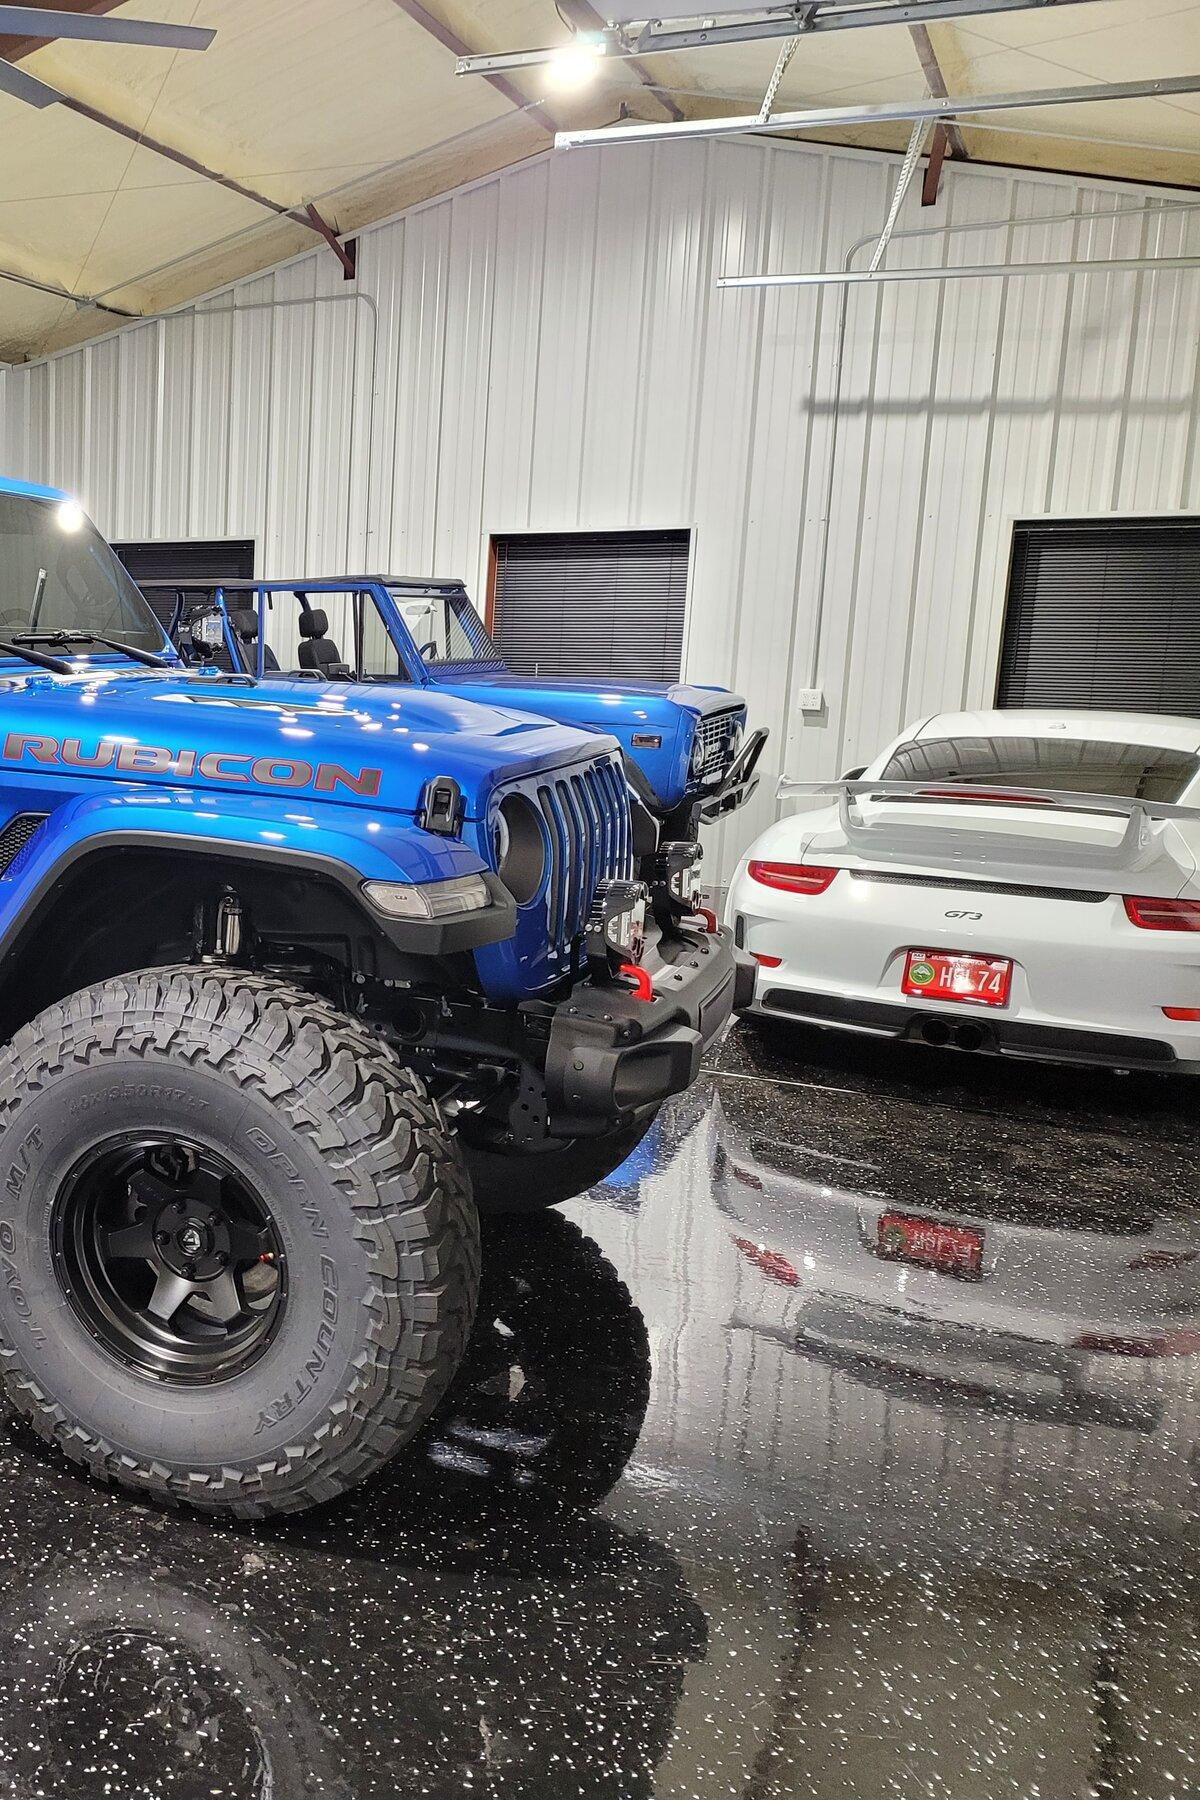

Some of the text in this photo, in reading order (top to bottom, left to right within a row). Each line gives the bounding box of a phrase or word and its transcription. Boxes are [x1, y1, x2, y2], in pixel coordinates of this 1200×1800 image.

[2, 732, 383, 797] RUBICON
[944, 910, 983, 921] GT3
[0, 1123, 48, 1350] TOYO M/T
[254, 1253, 339, 1436] COUNTRY
